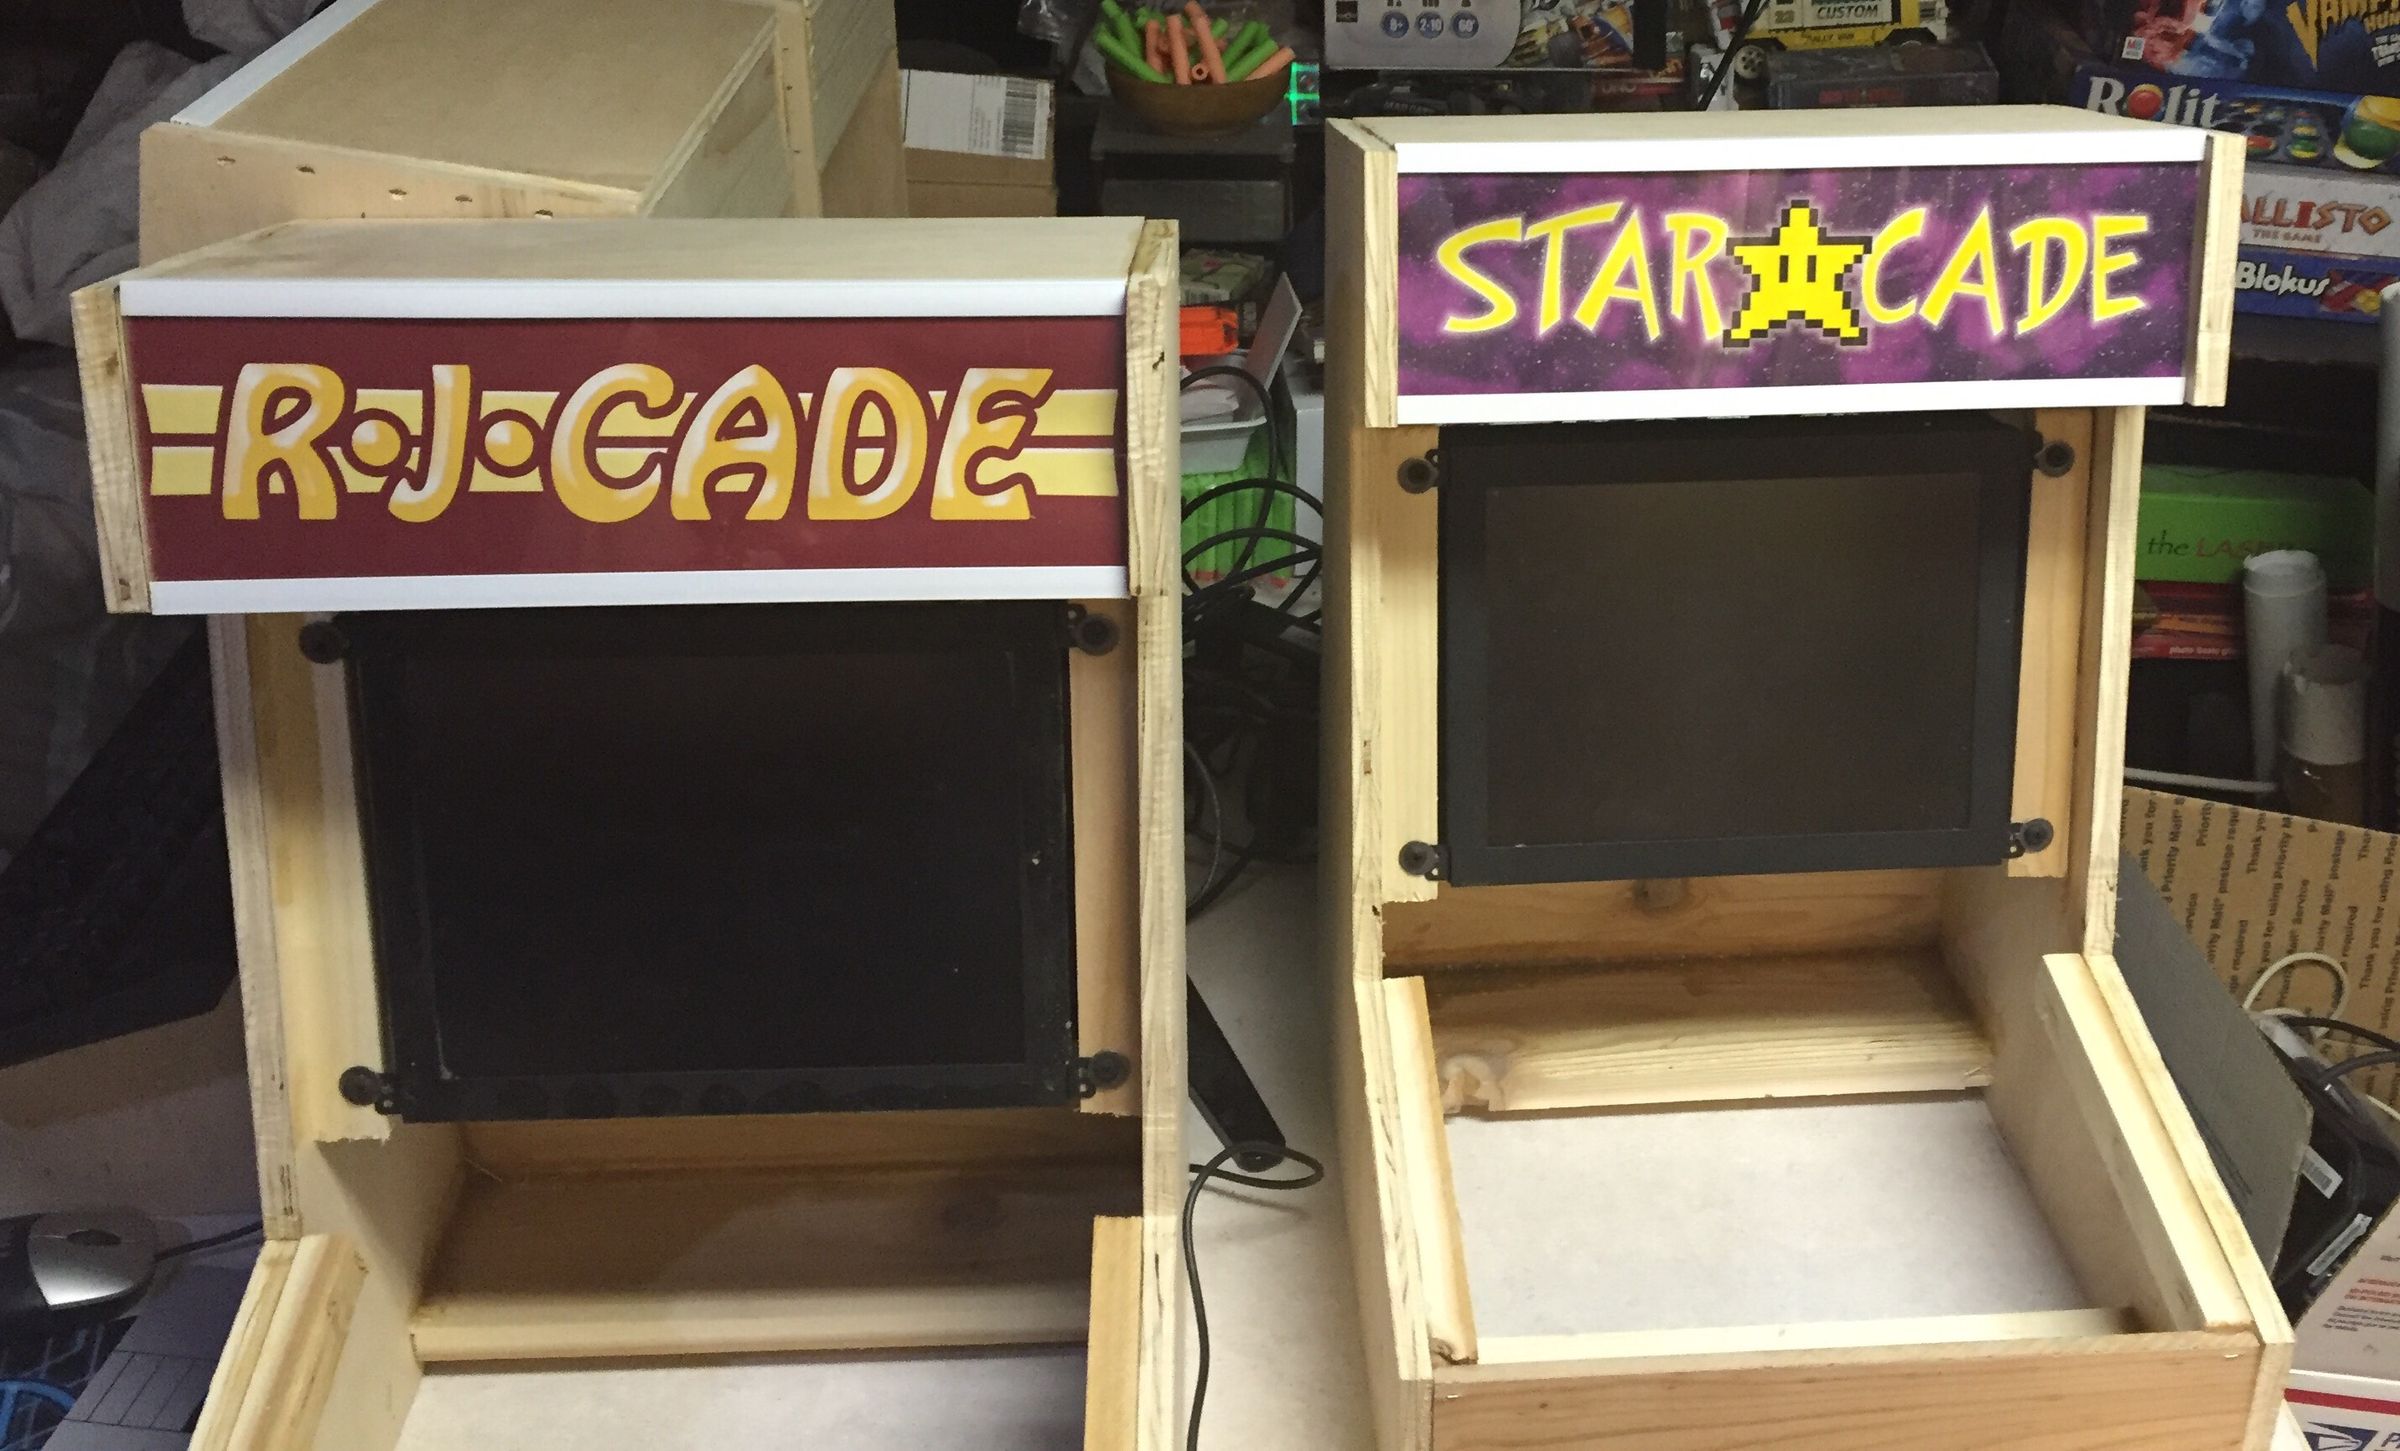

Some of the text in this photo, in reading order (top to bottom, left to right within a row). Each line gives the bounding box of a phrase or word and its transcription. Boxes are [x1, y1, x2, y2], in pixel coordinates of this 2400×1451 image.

[1817, 5, 1878, 20] CUSTOM
[2235, 261, 2330, 296] Blokus
[2148, 529, 2189, 556] the
[2161, 846, 2179, 892] Priority
[2218, 844, 2234, 893] postage
[2246, 836, 2262, 873] Thank
[2273, 832, 2292, 879] Priority
[2329, 830, 2346, 880] postage
[2268, 883, 2283, 916] using
[2292, 879, 2309, 925] Service
[2232, 920, 2248, 971] required
[2341, 906, 2358, 957] required
[2359, 953, 2376, 988] Thank
[2378, 869, 2393, 902] using
